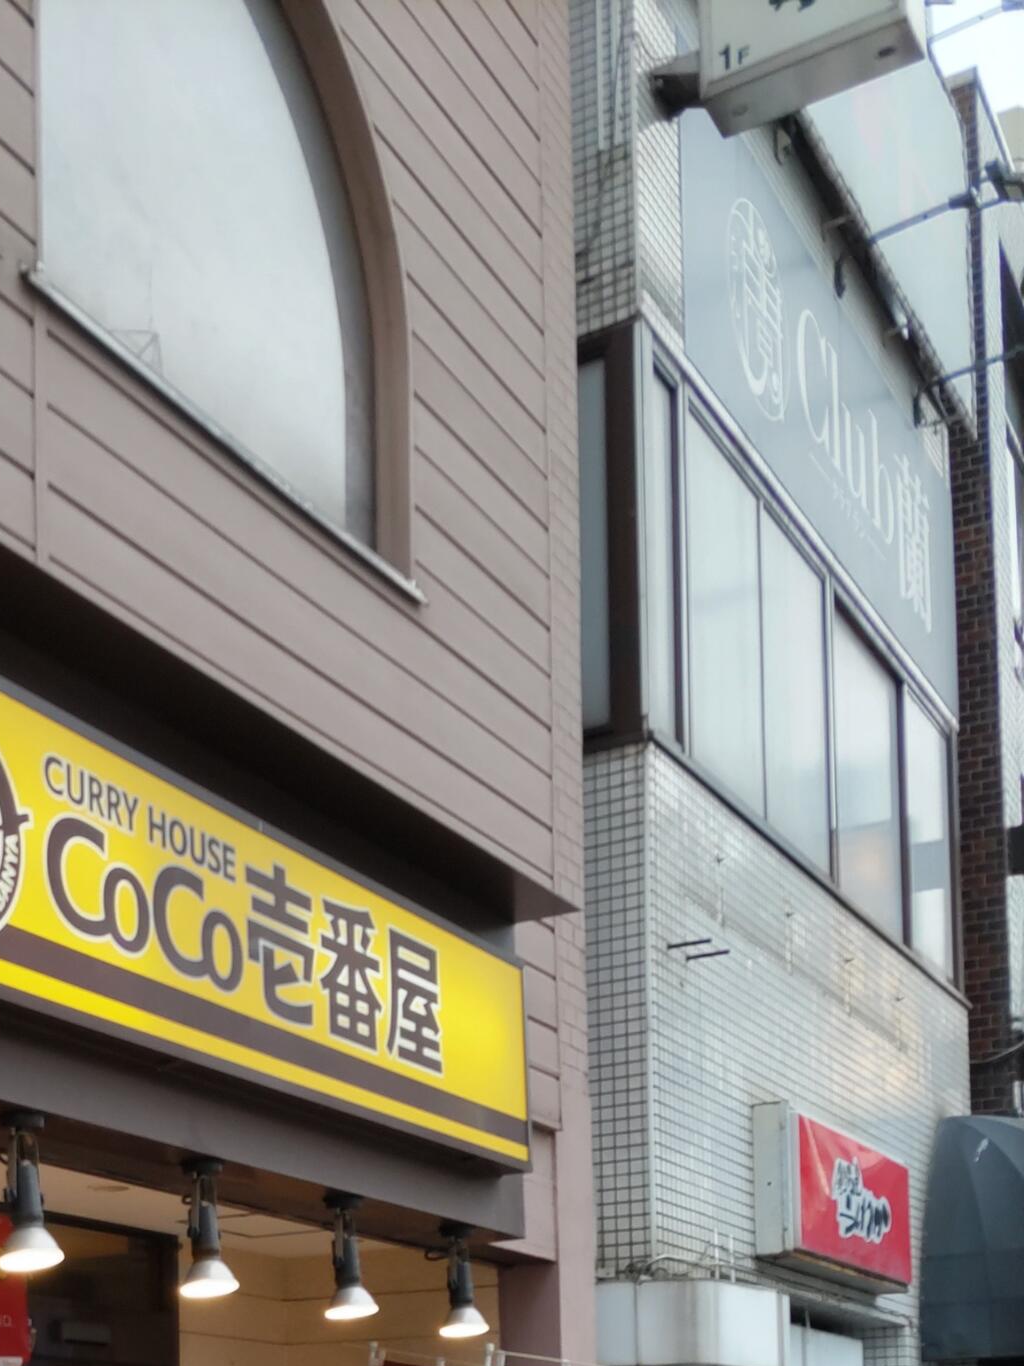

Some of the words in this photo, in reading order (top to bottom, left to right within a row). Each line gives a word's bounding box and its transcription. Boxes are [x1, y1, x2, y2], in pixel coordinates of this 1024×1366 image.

[44, 756, 138, 832] CURRY
[148, 805, 237, 883] HOUSE
[46, 815, 444, 1074] CoCo壱番屋
